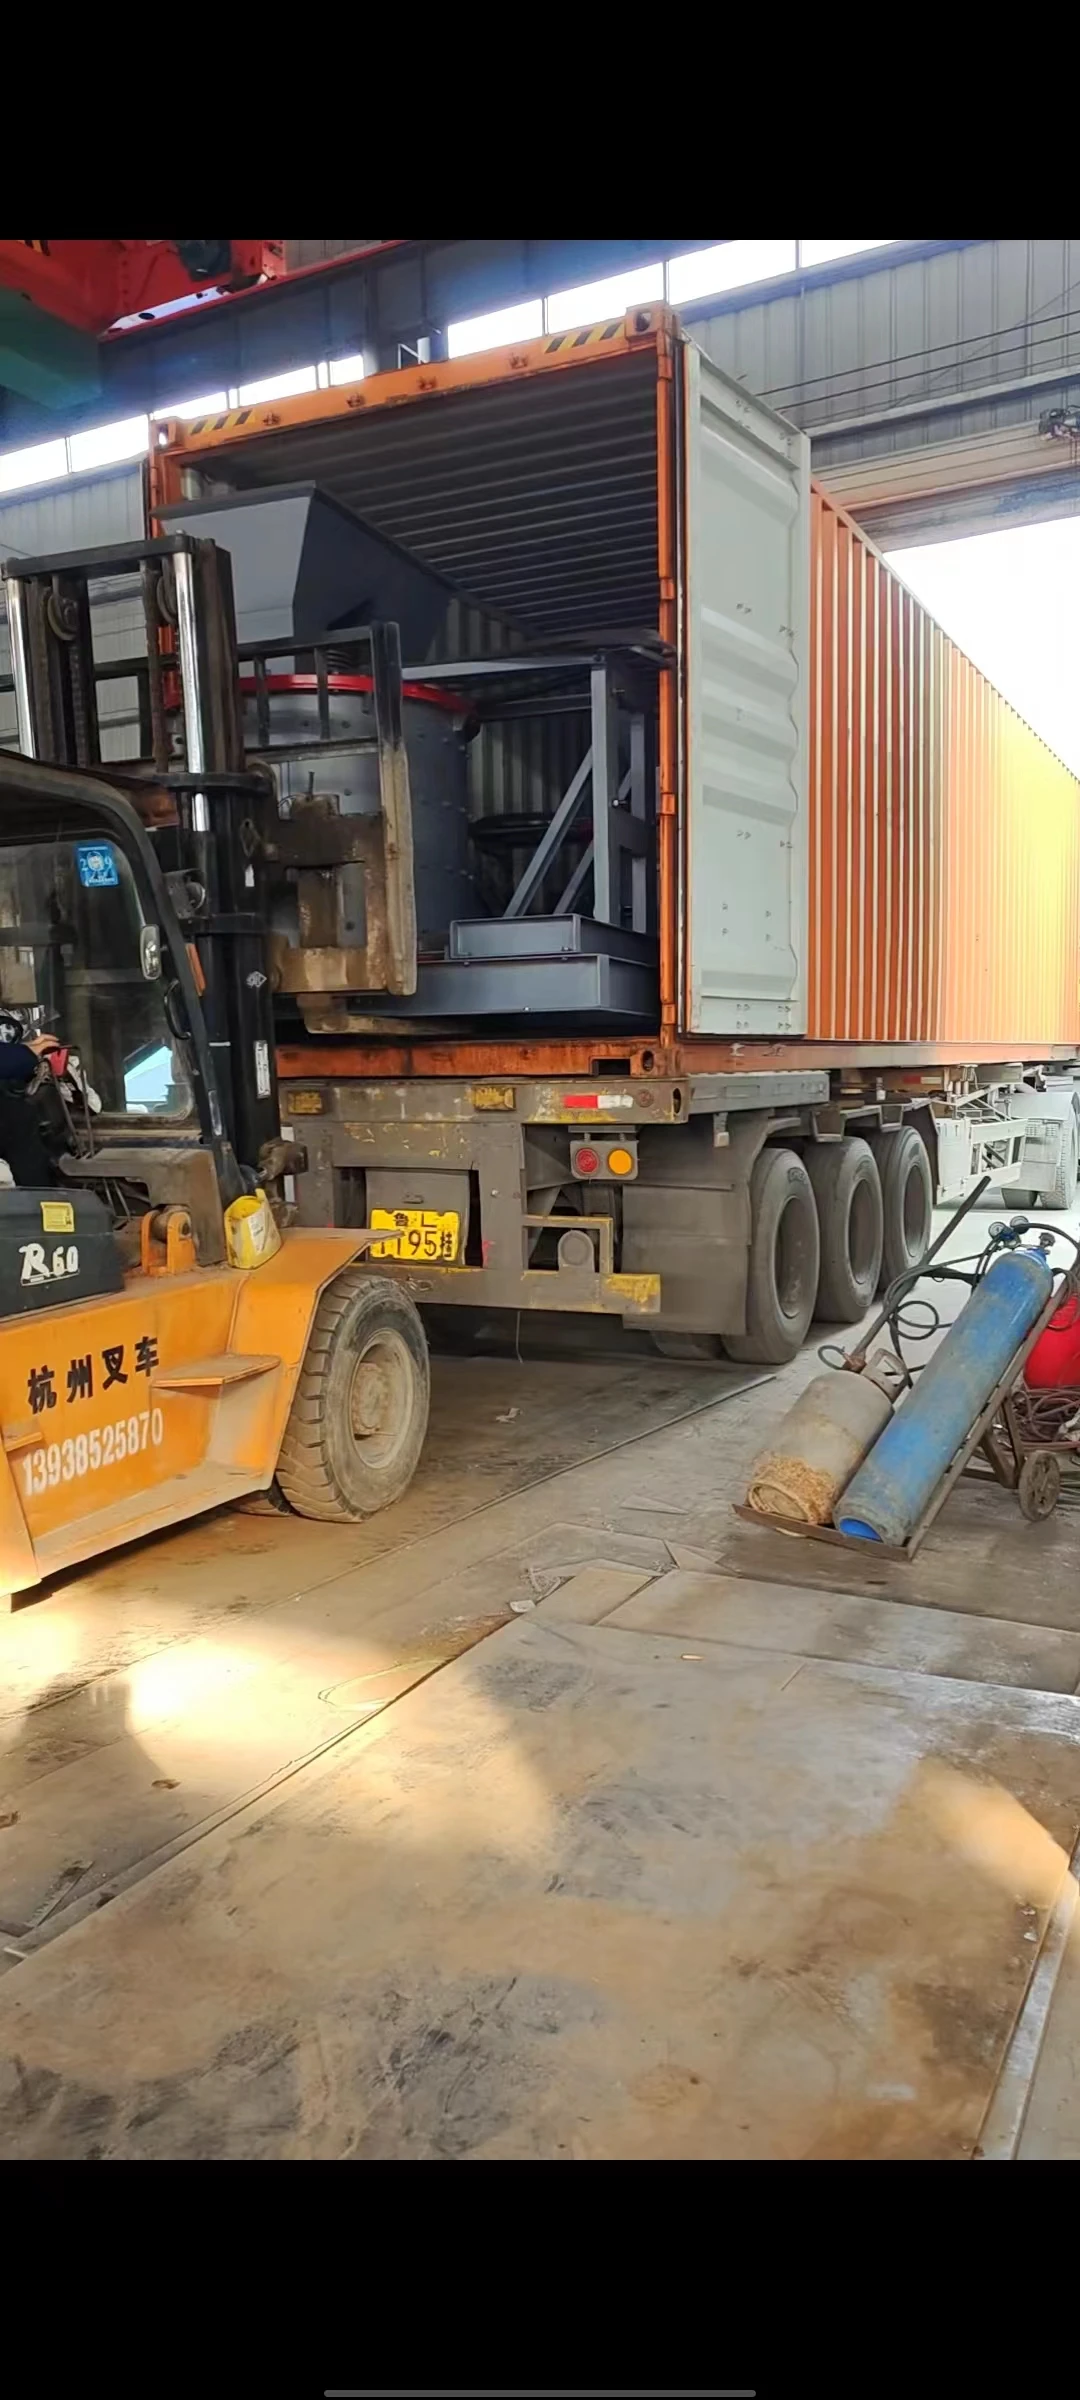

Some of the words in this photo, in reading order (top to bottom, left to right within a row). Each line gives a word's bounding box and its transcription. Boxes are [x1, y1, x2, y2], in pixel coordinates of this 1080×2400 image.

[18, 1242, 79, 1280] R60
[27, 1336, 160, 1415] 杭州叉车
[22, 1407, 164, 1497] 13938525870
